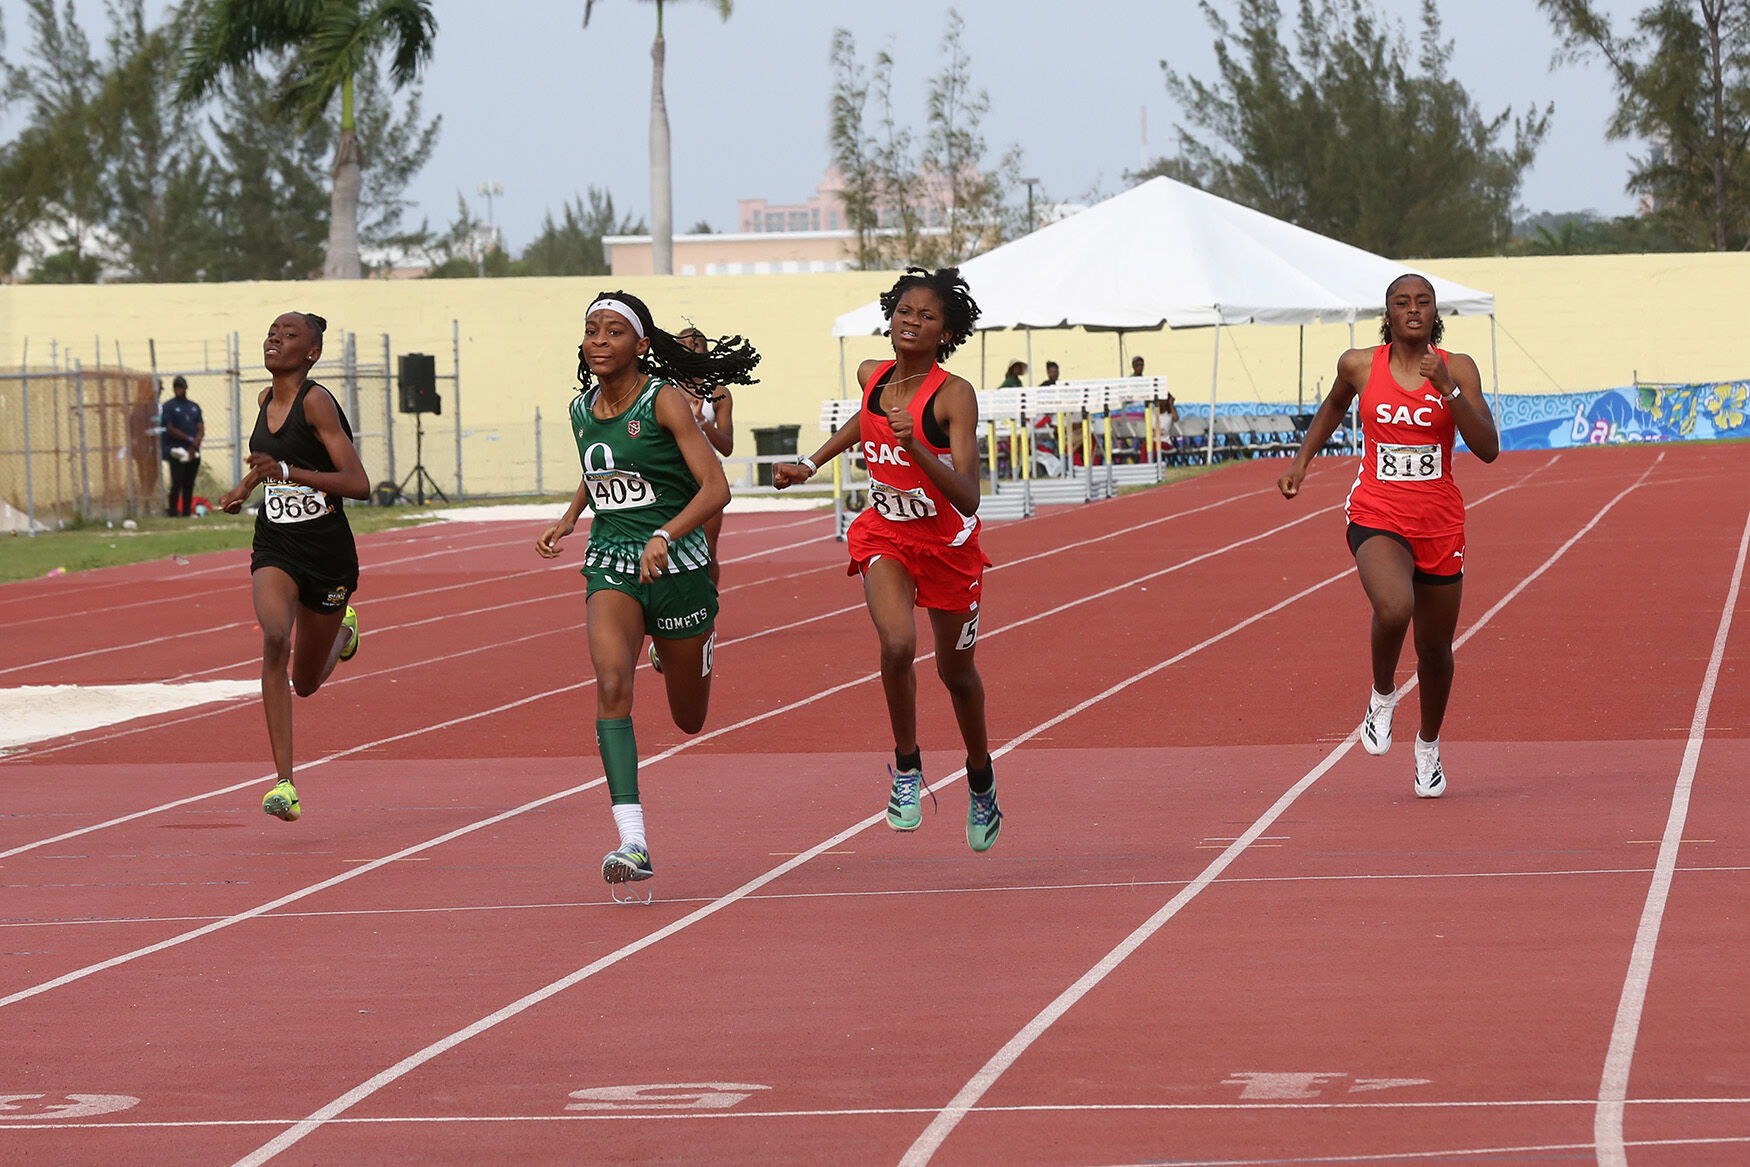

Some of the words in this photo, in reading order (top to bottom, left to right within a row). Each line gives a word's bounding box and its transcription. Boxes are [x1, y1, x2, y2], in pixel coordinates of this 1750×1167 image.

[1376, 403, 1433, 427] SAC
[864, 441, 911, 467] SAC
[1381, 454, 1435, 477] 818
[595, 478, 647, 505] 409
[268, 494, 321, 519] 966
[872, 491, 928, 518] 810
[657, 607, 708, 630] COMETS
[963, 618, 978, 649] 5
